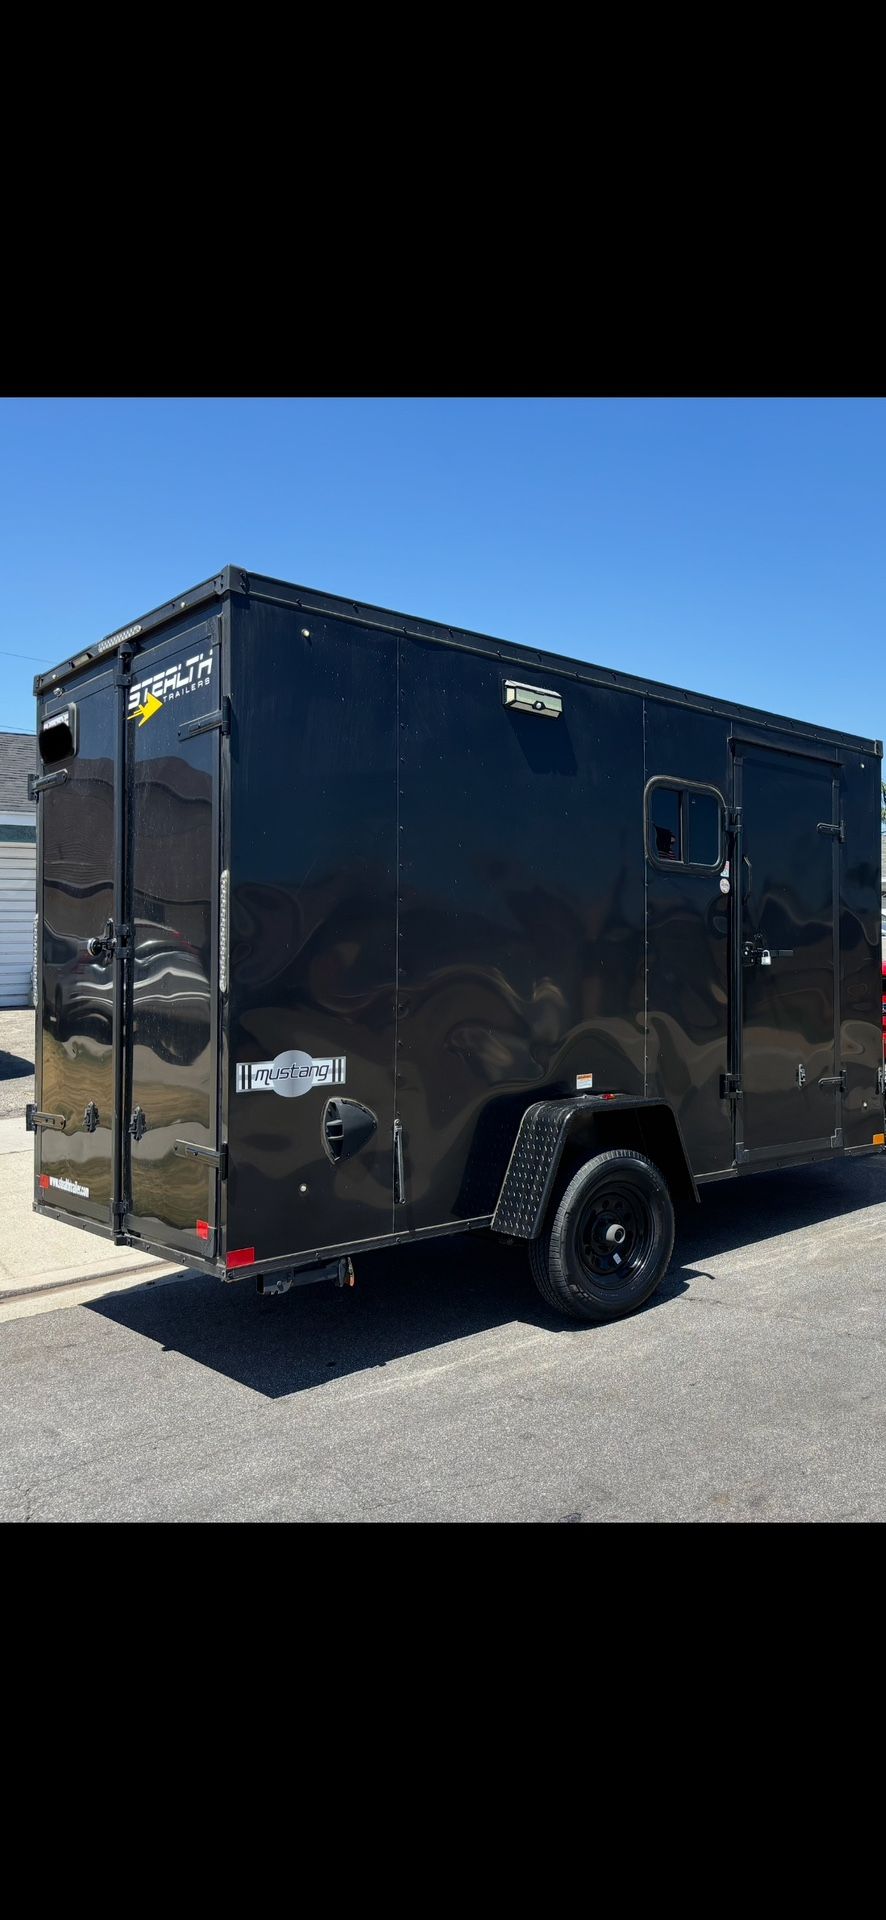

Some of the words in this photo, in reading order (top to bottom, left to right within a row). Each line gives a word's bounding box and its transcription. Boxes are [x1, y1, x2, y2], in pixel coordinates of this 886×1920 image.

[128, 650, 213, 710] STEALTH
[163, 677, 210, 702] TRAILERS
[255, 1062, 330, 1086] mustang
